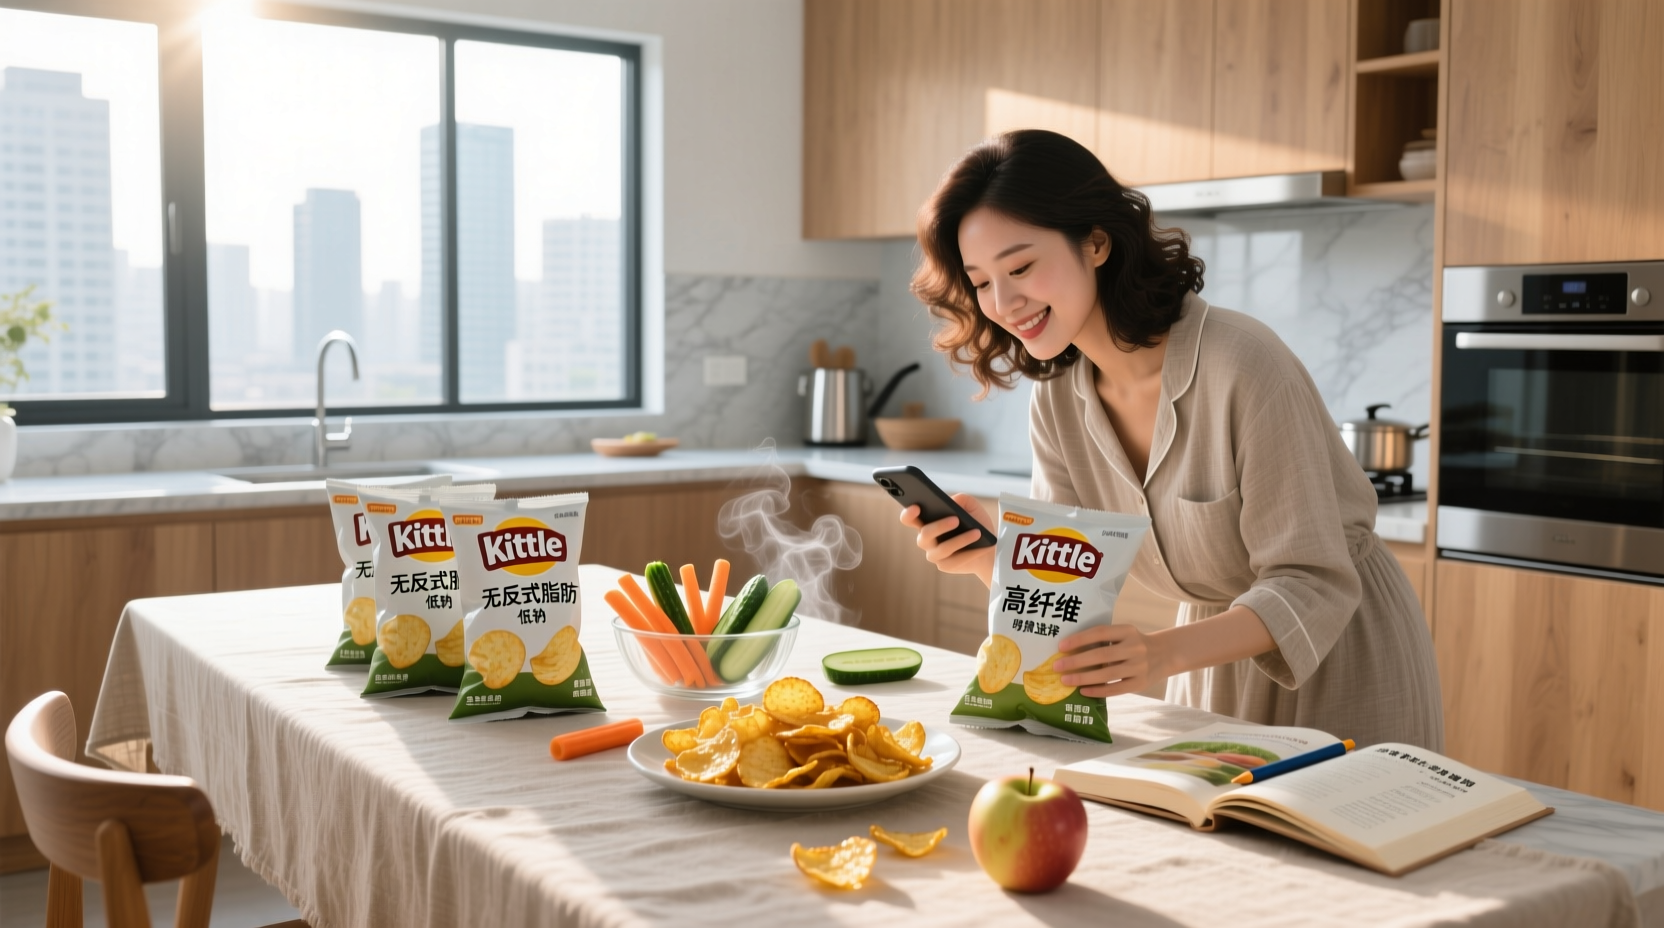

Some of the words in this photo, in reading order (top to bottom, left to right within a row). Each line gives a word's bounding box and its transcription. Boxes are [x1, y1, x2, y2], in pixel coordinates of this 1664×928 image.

[392, 522, 453, 553] Kittl
[483, 530, 563, 566] Kittle
[1016, 536, 1096, 573] Kittle
[390, 570, 459, 595] 无反式
[481, 581, 579, 610] 无反式脂肪
[1002, 584, 1082, 623] 高纤维
